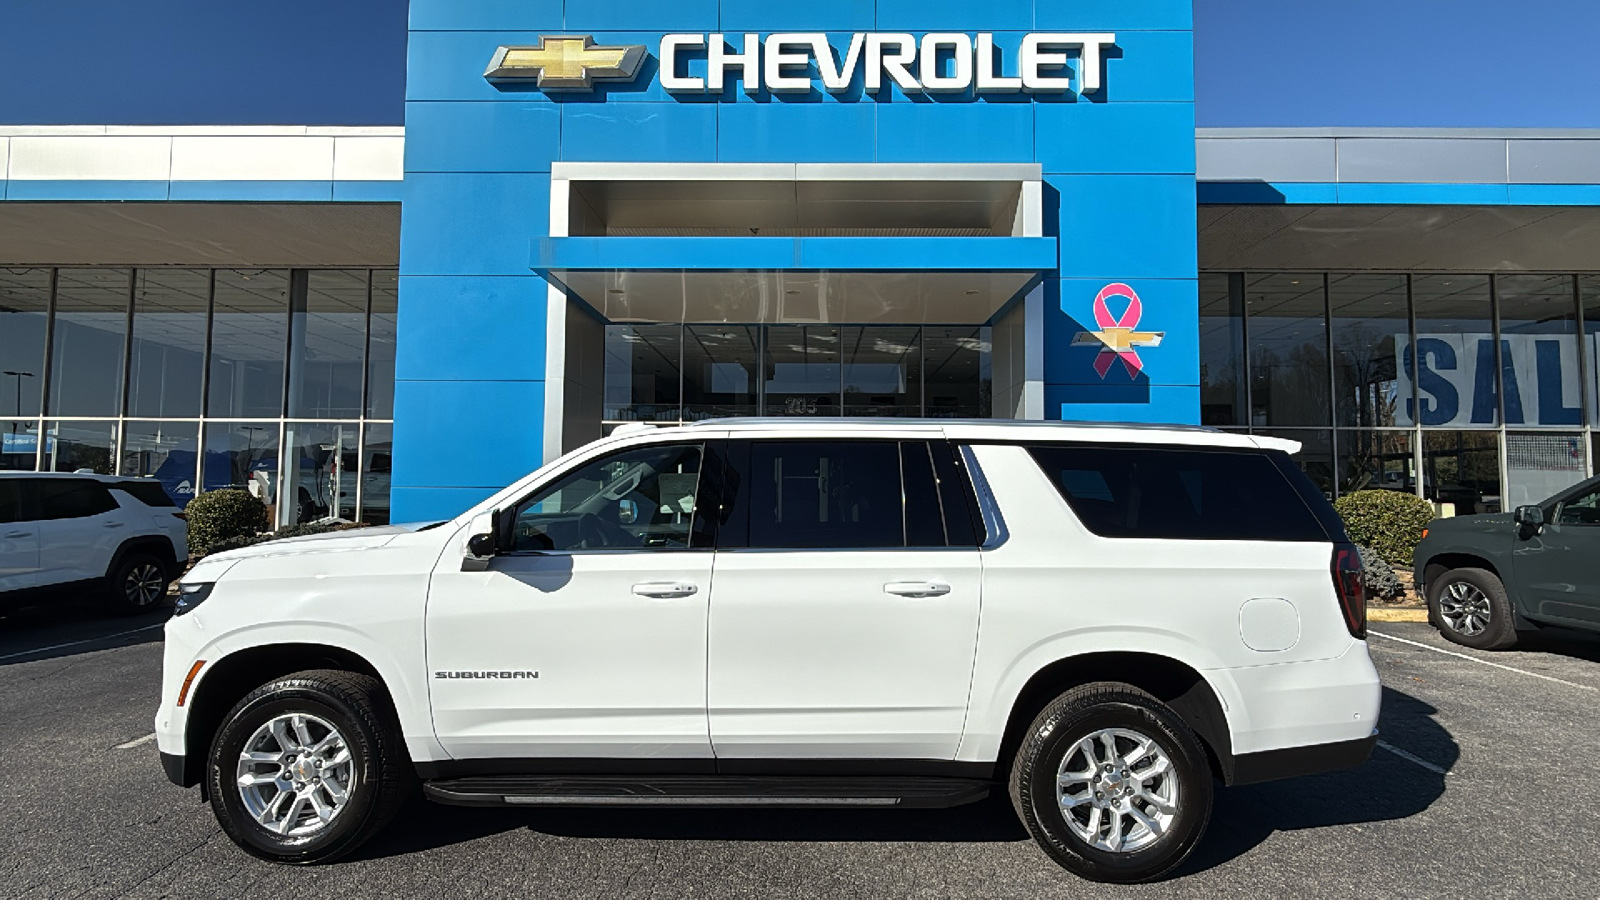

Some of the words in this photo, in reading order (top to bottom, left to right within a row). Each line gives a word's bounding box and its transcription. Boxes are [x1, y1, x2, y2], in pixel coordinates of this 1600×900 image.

[659, 33, 1116, 92] CHEVROLET
[1403, 338, 1582, 425] SAL
[434, 671, 539, 679] SUBURBAN
